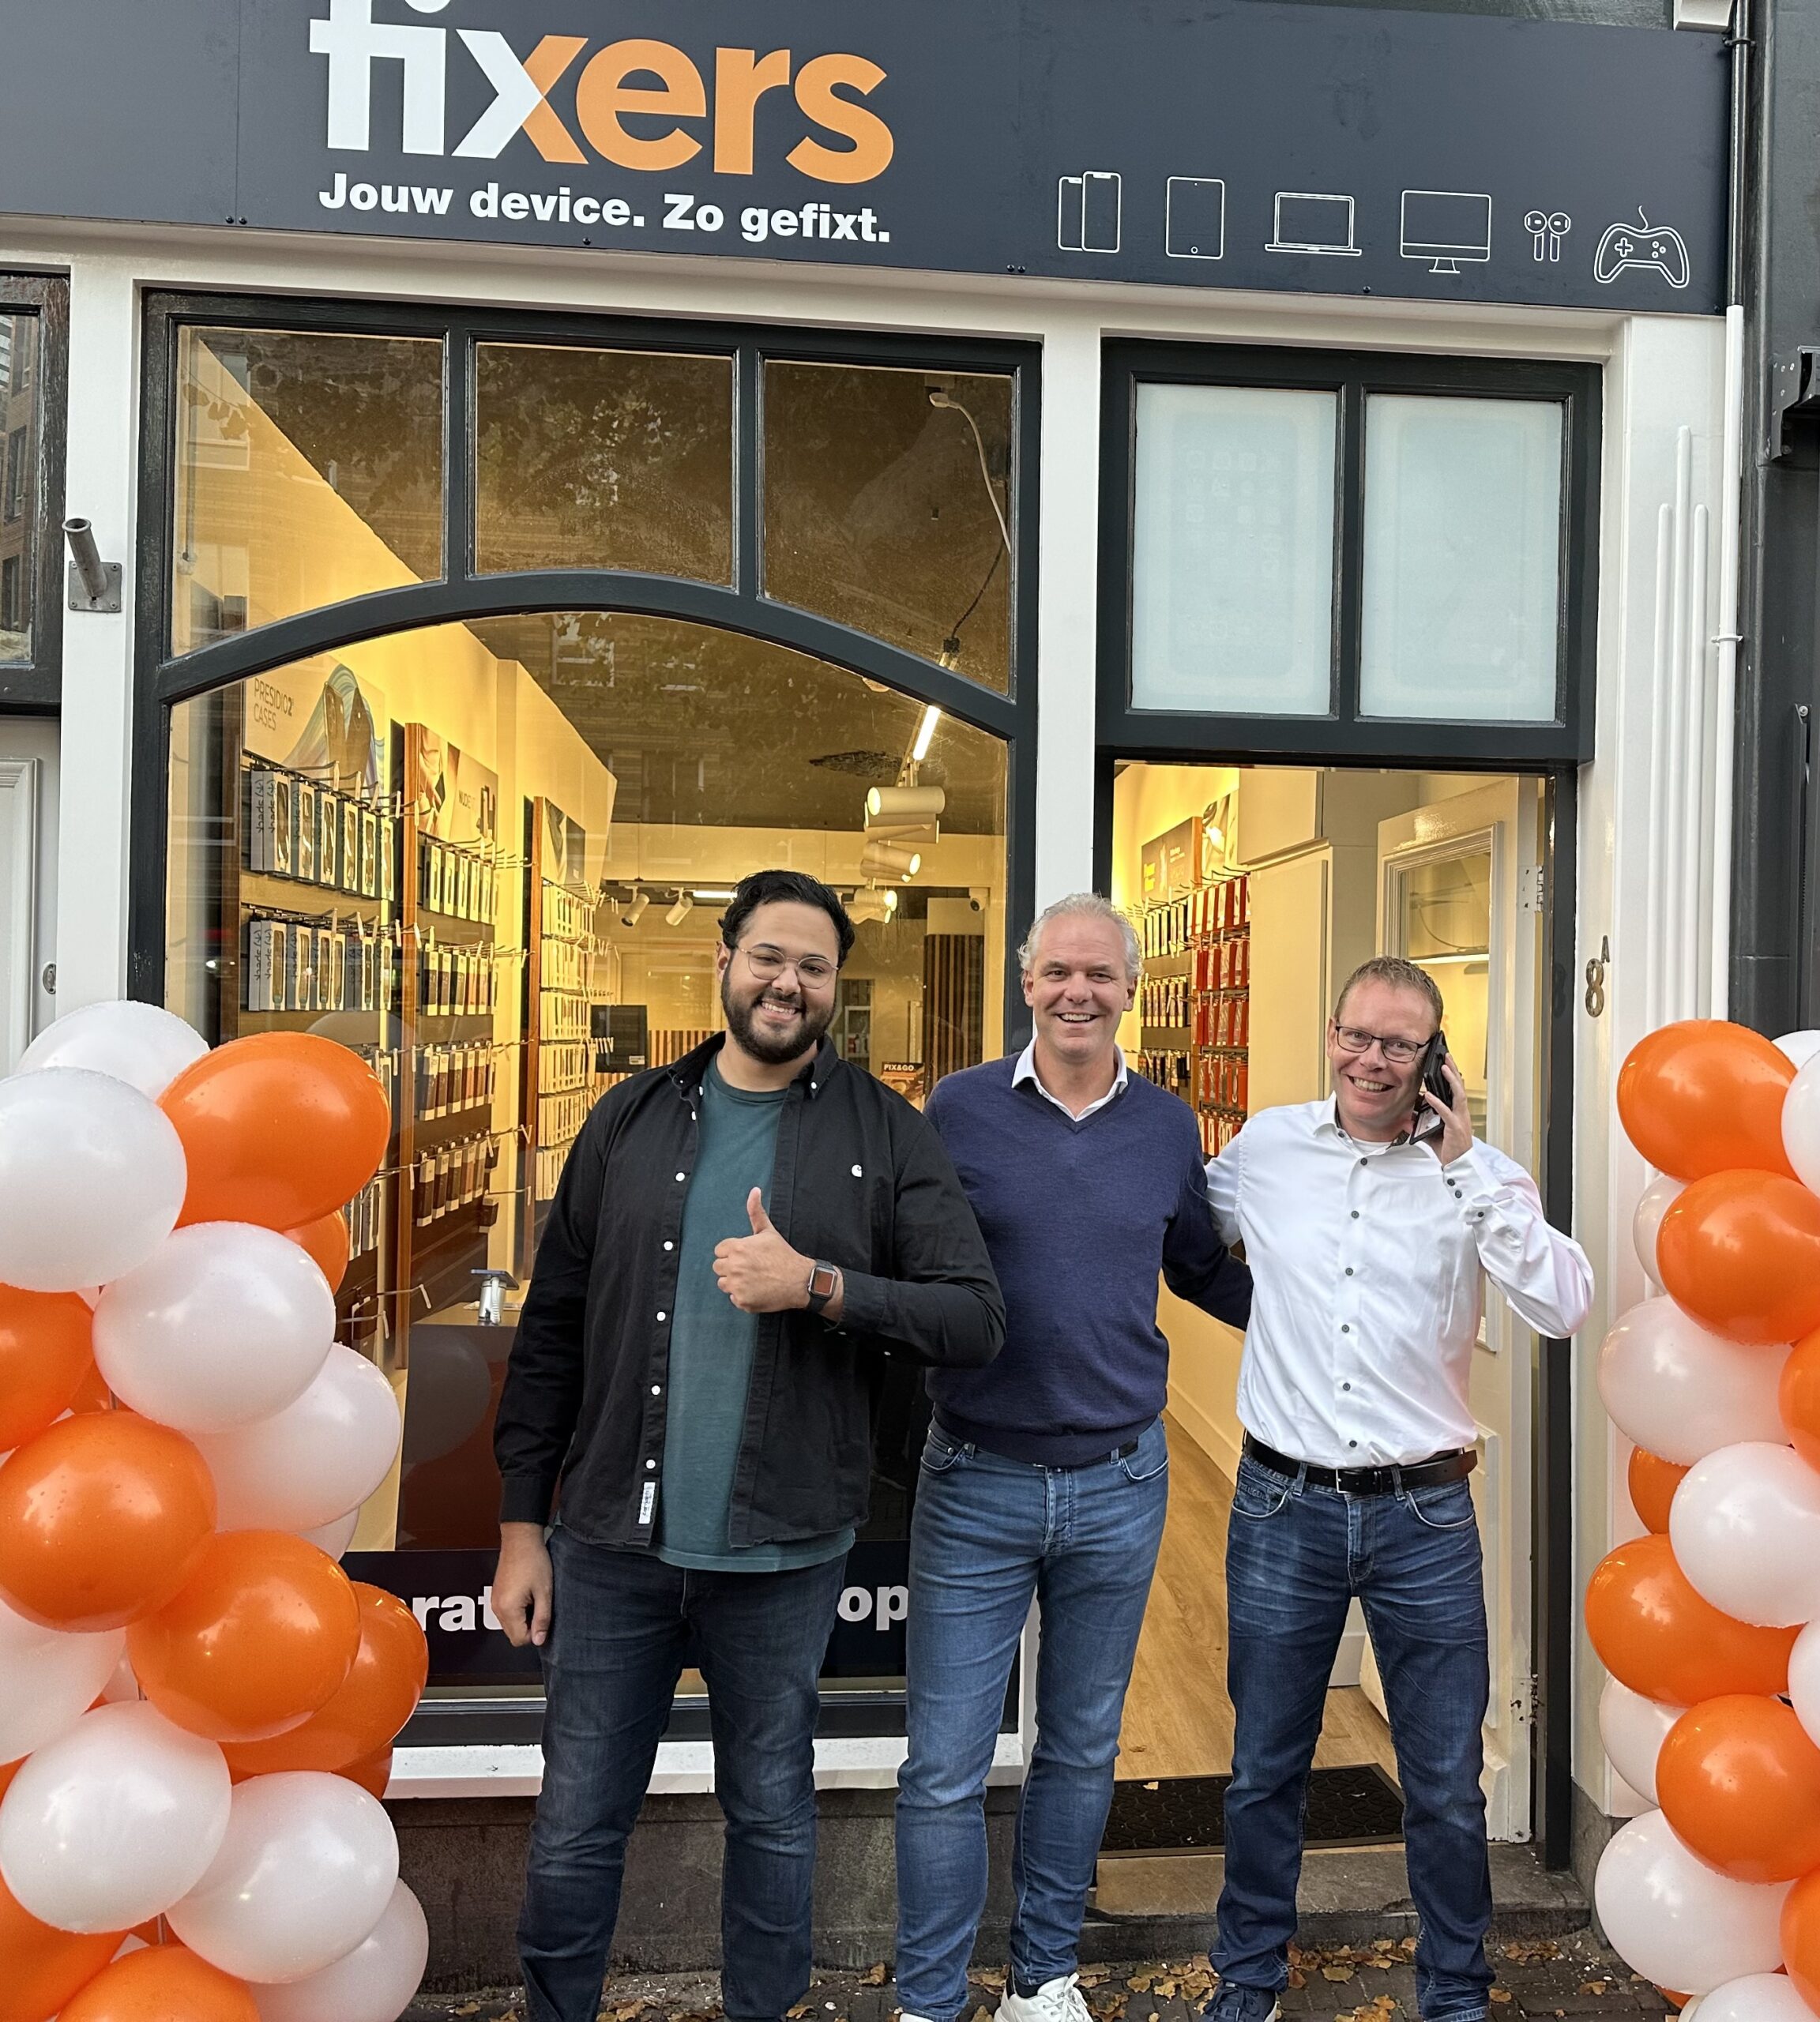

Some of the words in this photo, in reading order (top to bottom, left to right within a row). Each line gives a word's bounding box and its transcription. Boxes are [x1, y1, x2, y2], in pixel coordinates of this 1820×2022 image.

[310, 0, 894, 184] fixers
[318, 173, 454, 215] Jouw
[469, 182, 645, 227] device.
[662, 194, 724, 232] Zo
[740, 202, 890, 243] gefixt.
[254, 703, 276, 731] CASES
[398, 1585, 504, 1632] rat
